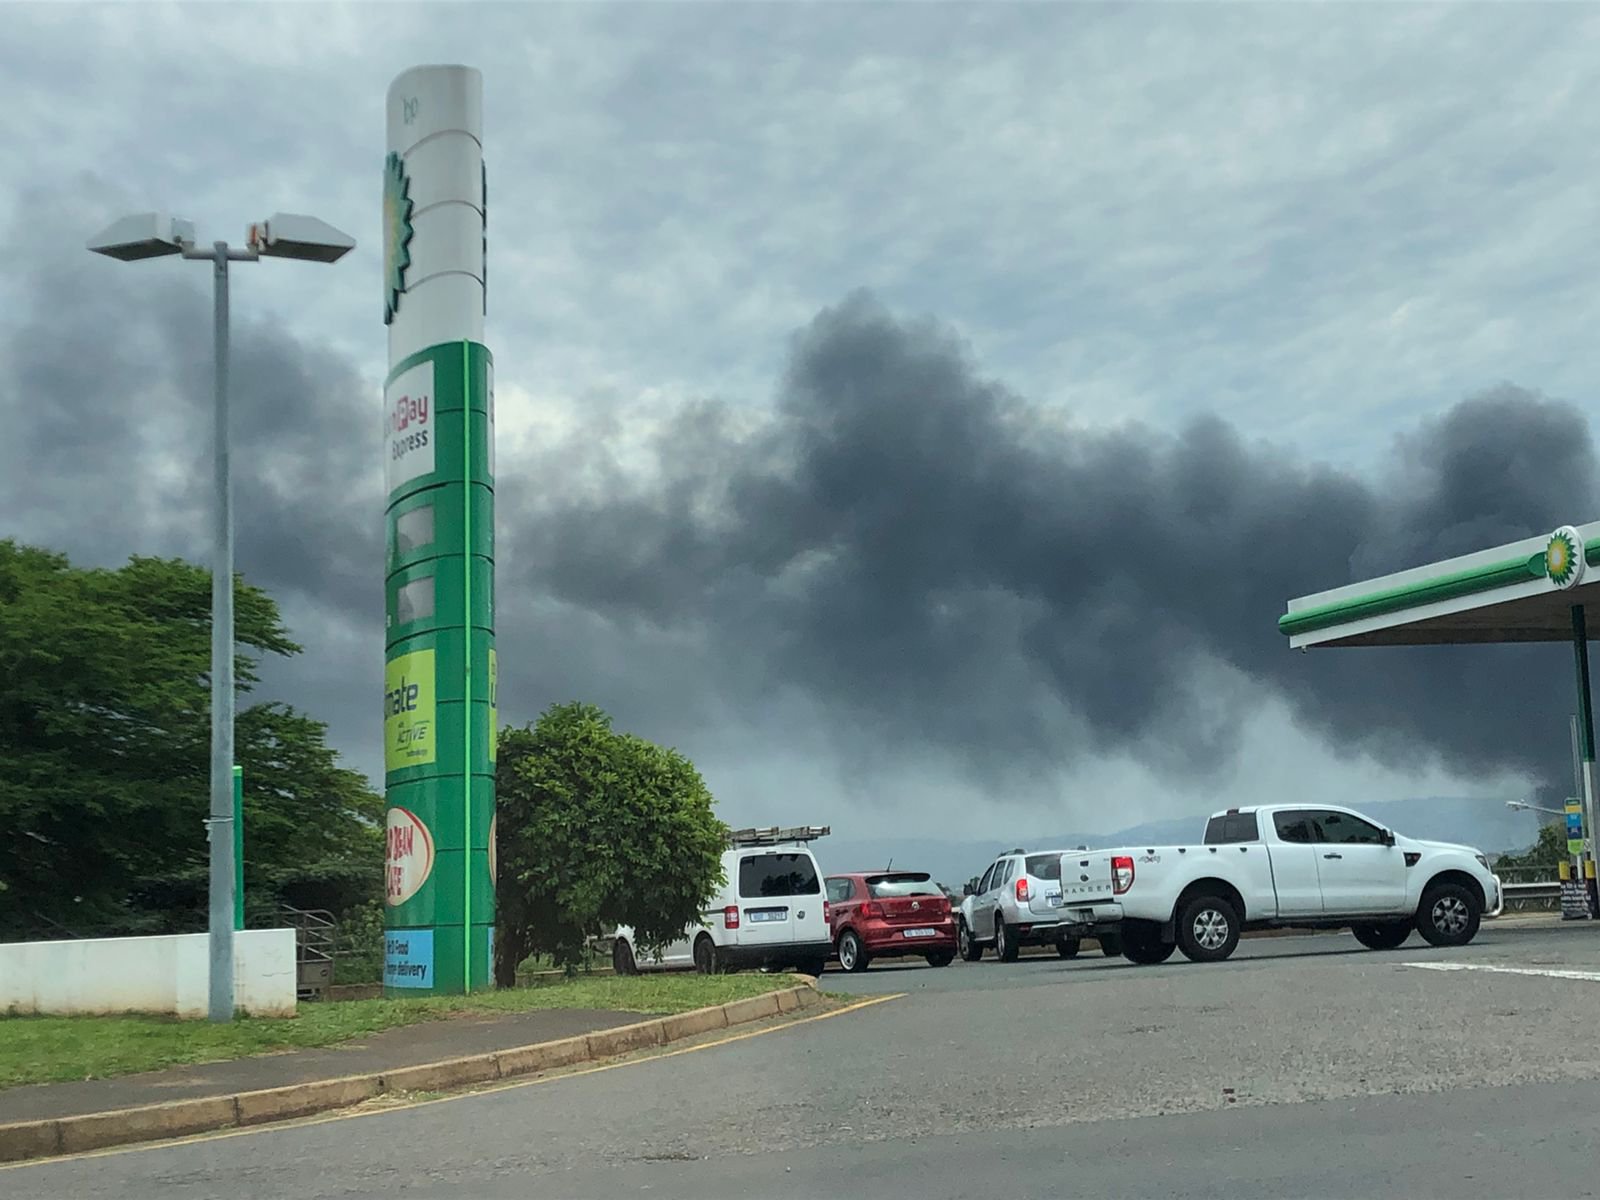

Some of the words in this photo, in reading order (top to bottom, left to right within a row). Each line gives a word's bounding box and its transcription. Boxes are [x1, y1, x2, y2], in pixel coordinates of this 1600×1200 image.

[401, 95, 419, 125] bp
[392, 430, 428, 461] Express
[397, 725, 427, 746] ACTIVE
[394, 825, 413, 861] BEAN
[1064, 884, 1111, 895] RANGER
[398, 960, 427, 981] delivery
